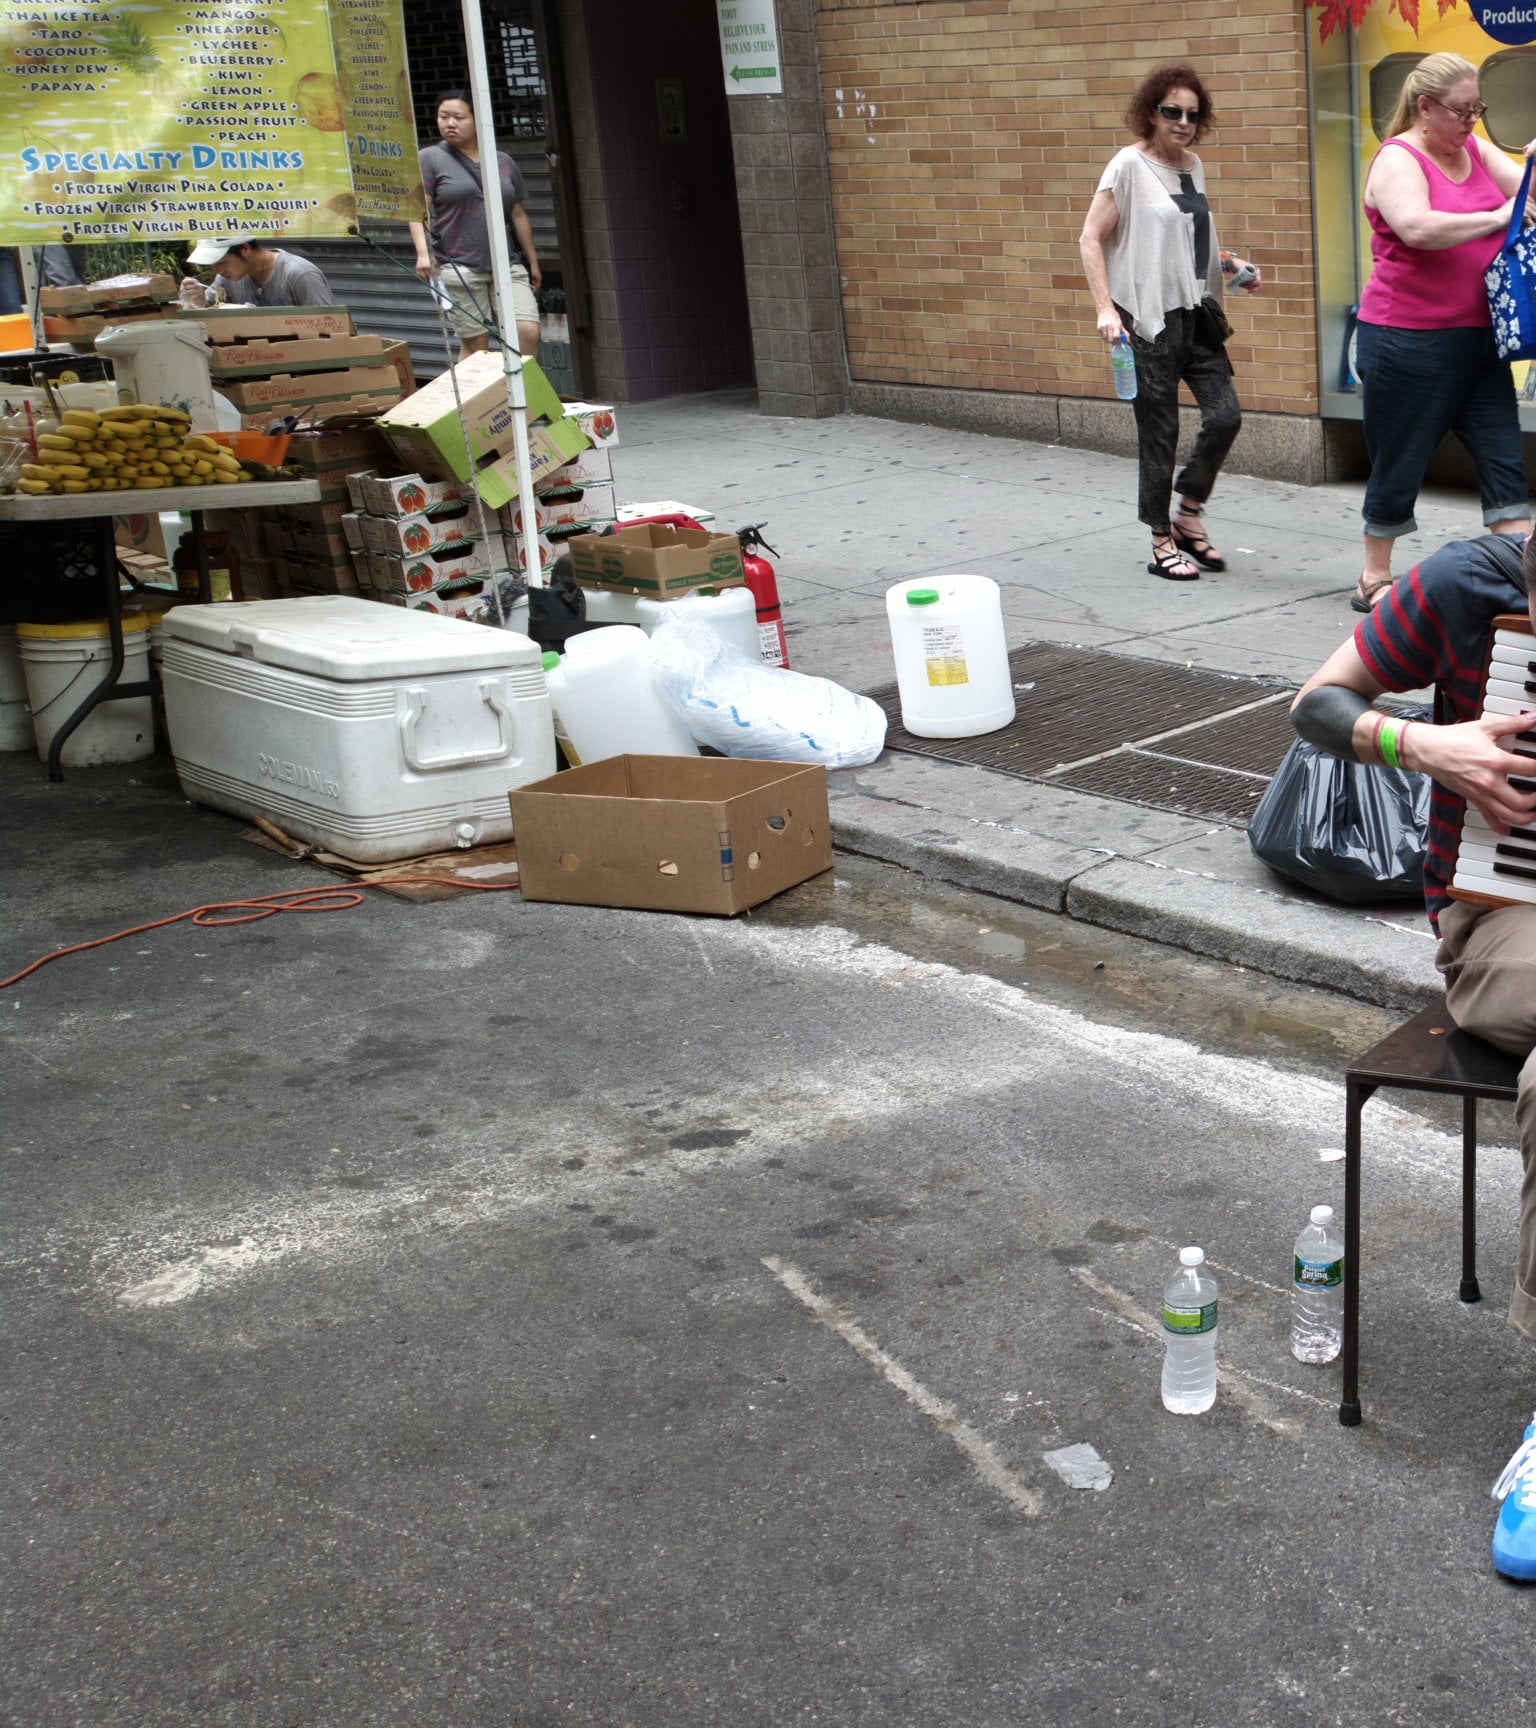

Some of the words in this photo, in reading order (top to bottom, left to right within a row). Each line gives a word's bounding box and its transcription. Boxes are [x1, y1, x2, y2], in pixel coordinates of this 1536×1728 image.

[5, 12, 47, 21] THAI
[55, 12, 77, 21] ICE
[82, 12, 110, 21] TEA
[195, 10, 255, 19] MANGO
[40, 30, 82, 39] TARO
[185, 25, 269, 35] PINEAPPLE
[723, 24, 749, 37] RELIEVE
[749, 23, 766, 36] YOUR
[202, 41, 258, 49] LYCHEE
[725, 42, 739, 54] PAIN
[739, 42, 752, 53] AND
[753, 41, 775, 53] STRESS
[24, 47, 98, 56] COCONUT
[189, 56, 273, 65] BLUEBERRY
[15, 65, 69, 74] HONEY
[76, 65, 108, 73] DEW
[218, 71, 252, 80] KIWI
[31, 83, 96, 91] PAPAYA
[212, 86, 262, 95] LEMON
[191, 101, 237, 110] GREEN
[243, 102, 287, 111] APPLE
[186, 116, 248, 126] PASSION
[254, 117, 297, 126] FRUIT
[219, 132, 266, 141] PEACH
[357, 134, 403, 158] DRINKS
[21, 147, 182, 171] SPECIALTY
[192, 145, 303, 169] DRINKS
[66, 181, 123, 195] FROZEN
[127, 180, 176, 193] VIRGIN
[181, 180, 216, 192] PINA
[220, 180, 274, 192] COLADA
[34, 202, 92, 215] FROZEN
[97, 201, 146, 214] VIRGIN
[152, 199, 239, 212] STRAWBERRY
[243, 198, 308, 211] DAIQUIRI
[74, 222, 128, 235] FROZEN
[132, 220, 183, 232] VIRGIN
[188, 219, 222, 231] BLUE
[226, 218, 280, 230] HAWAII
[488, 415, 512, 436] amily
[258, 753, 323, 795] COLEMAN
[1304, 1264, 1326, 1273] Poland
[1302, 1270, 1328, 1281] Spring
